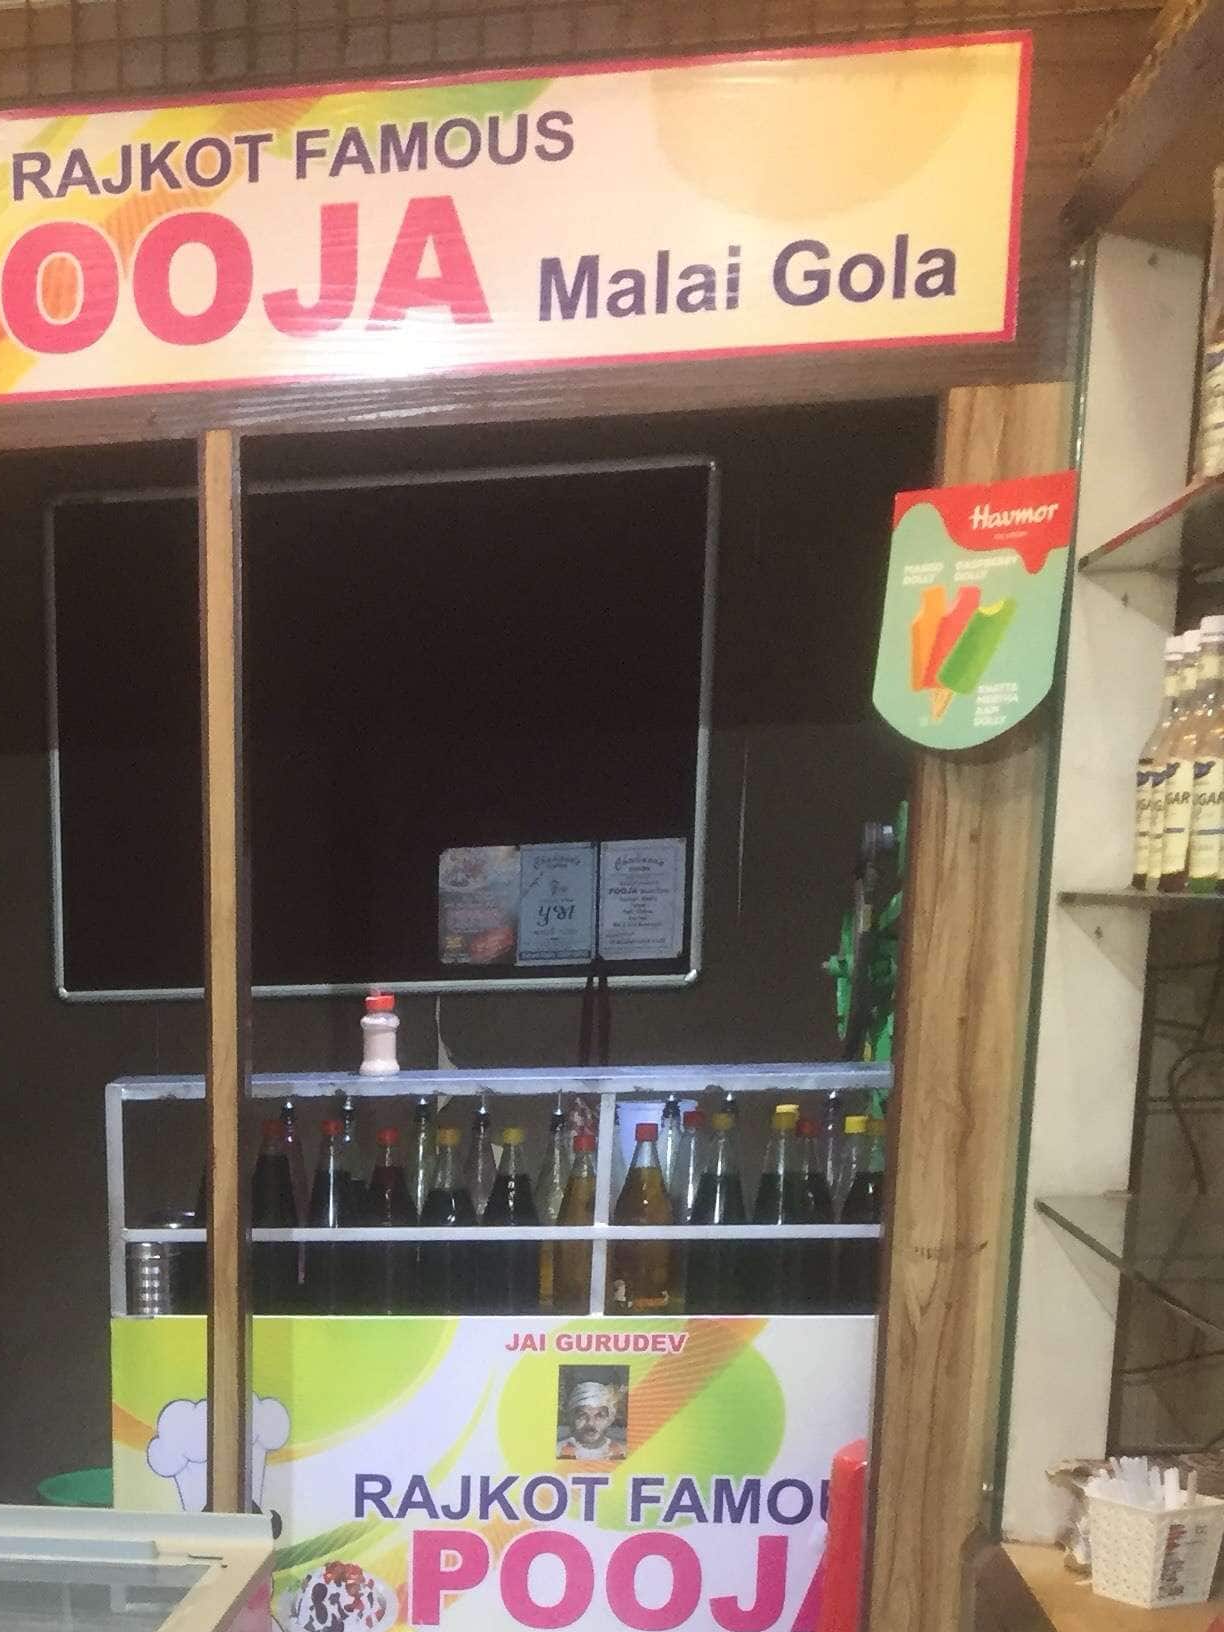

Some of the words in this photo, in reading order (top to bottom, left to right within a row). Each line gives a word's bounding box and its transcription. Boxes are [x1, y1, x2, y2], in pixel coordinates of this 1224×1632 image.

[12, 132, 273, 201] RAJKOT
[295, 110, 575, 179] FAMOUS
[538, 245, 741, 323] Malai
[772, 233, 957, 307] Gola
[969, 503, 1059, 530] Havmor
[505, 1333, 546, 1352] JAI
[556, 1333, 687, 1353] GURUDEV
[354, 1473, 609, 1524] RAJKOT
